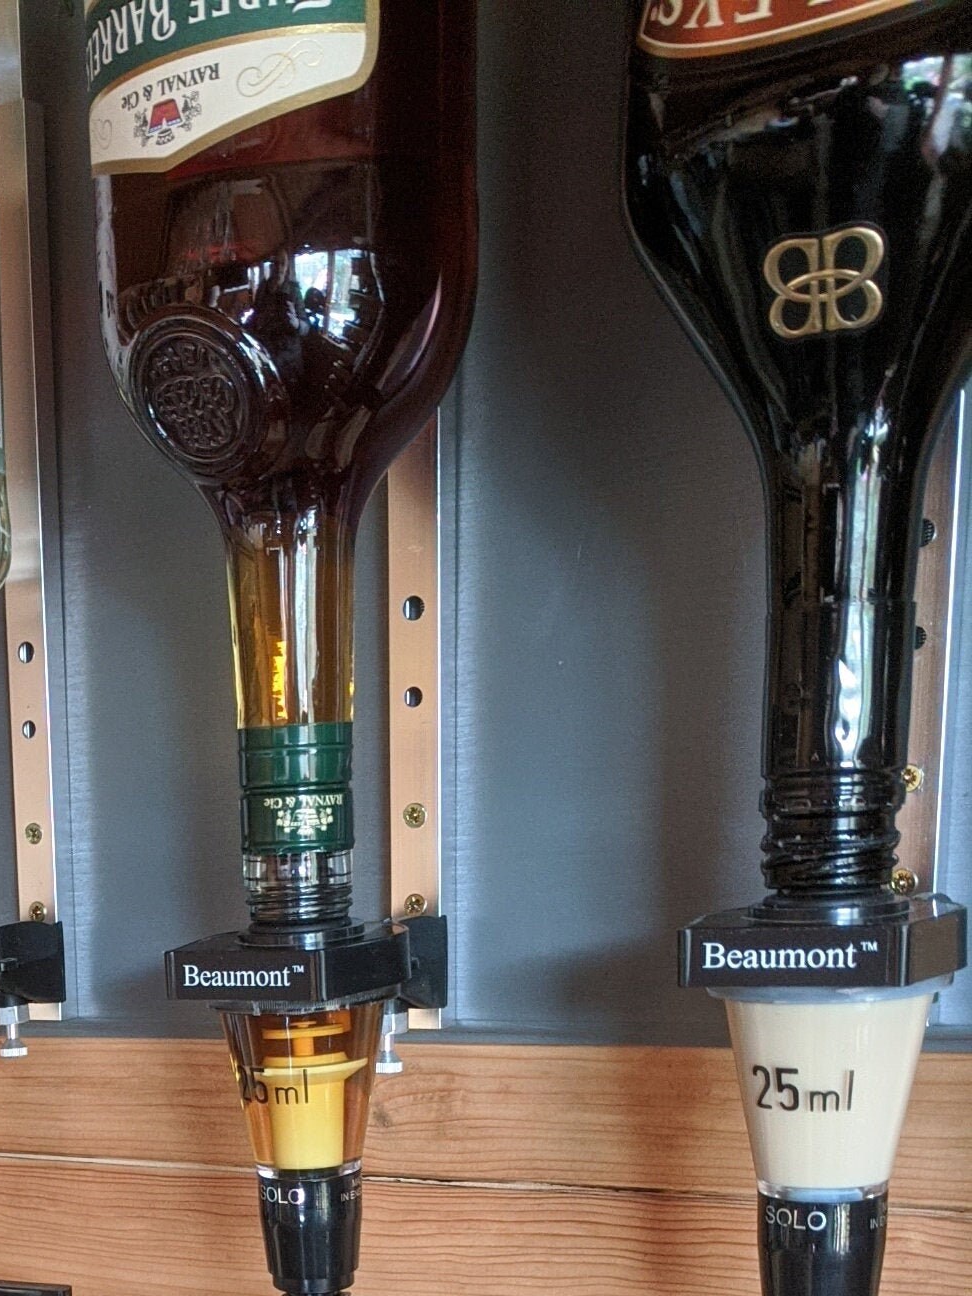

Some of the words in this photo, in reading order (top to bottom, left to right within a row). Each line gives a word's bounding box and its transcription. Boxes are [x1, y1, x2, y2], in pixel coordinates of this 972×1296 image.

[156, 62, 220, 95] RAYNAL
[121, 90, 140, 110] Cie
[142, 85, 154, 101] &
[263, 797, 283, 810] Cie
[285, 796, 296, 808] &
[298, 793, 343, 807] RAYNAL
[260, 1185, 306, 1206] SOLO
[765, 1206, 827, 1232] SOLO
